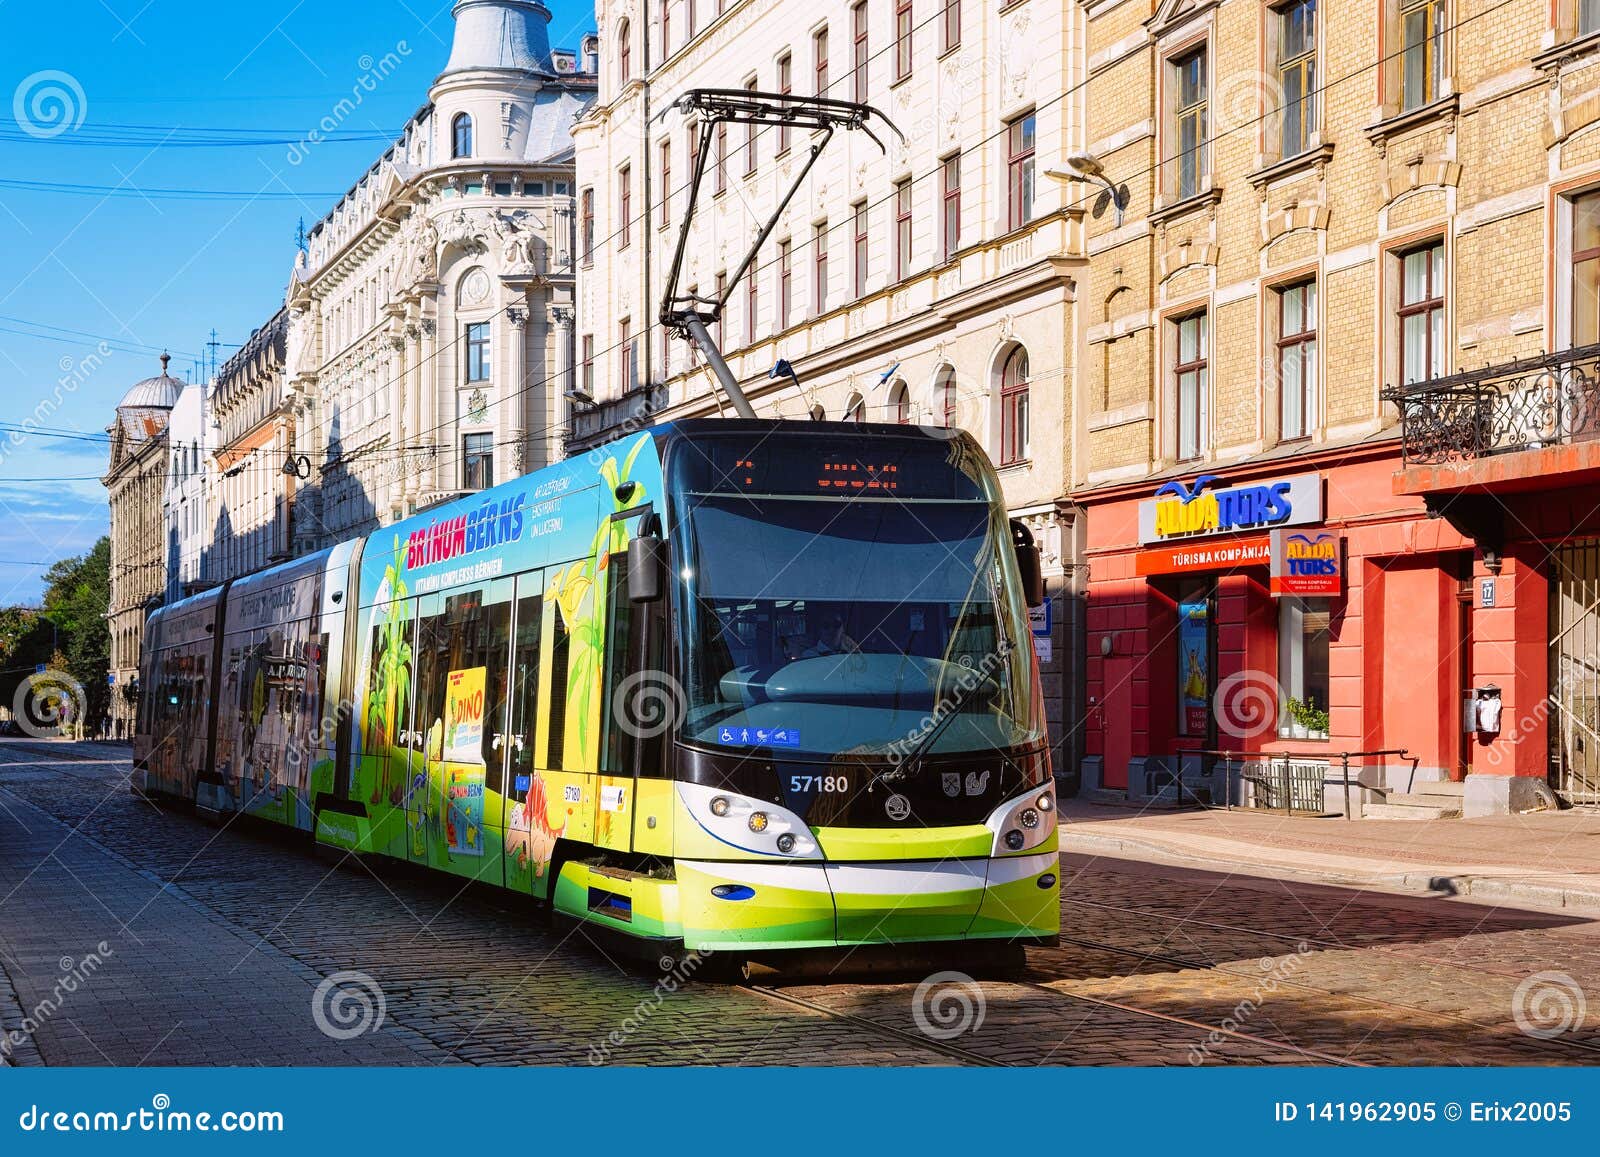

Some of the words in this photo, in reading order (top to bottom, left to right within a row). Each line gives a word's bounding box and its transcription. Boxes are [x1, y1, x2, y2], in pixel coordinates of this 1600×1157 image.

[1173, 551, 1212, 566] TŪRISMA
[1214, 545, 1271, 562] KOMPĀNIJA
[1483, 586, 1493, 599] 17
[457, 689, 483, 724] DINO
[790, 775, 848, 792] 57180
[565, 786, 580, 801] 57180
